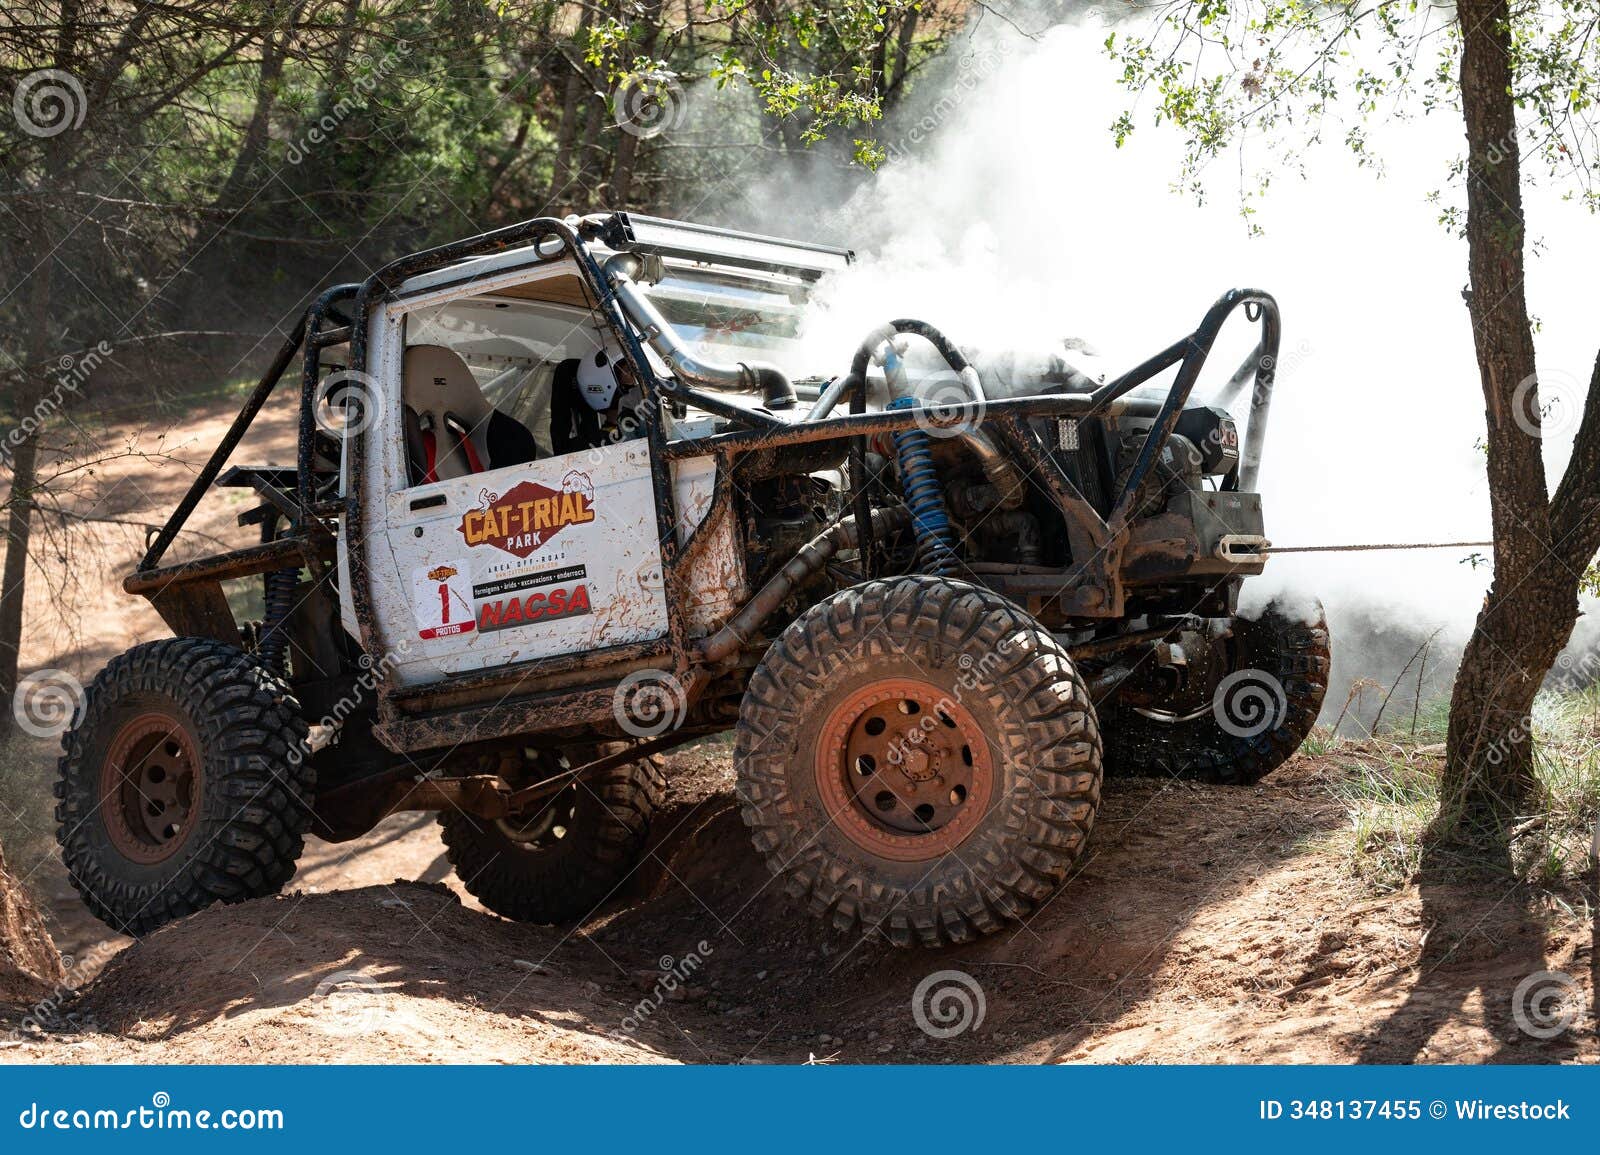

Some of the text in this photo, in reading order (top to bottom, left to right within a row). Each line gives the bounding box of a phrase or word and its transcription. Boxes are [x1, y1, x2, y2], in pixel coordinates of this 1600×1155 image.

[464, 491, 594, 543] CAT-TRIAL
[507, 532, 541, 550] PARK
[517, 552, 566, 568] OFF-ROAD
[438, 583, 450, 624] 1
[479, 584, 590, 629] NACSA
[435, 624, 461, 637] PROTOS
